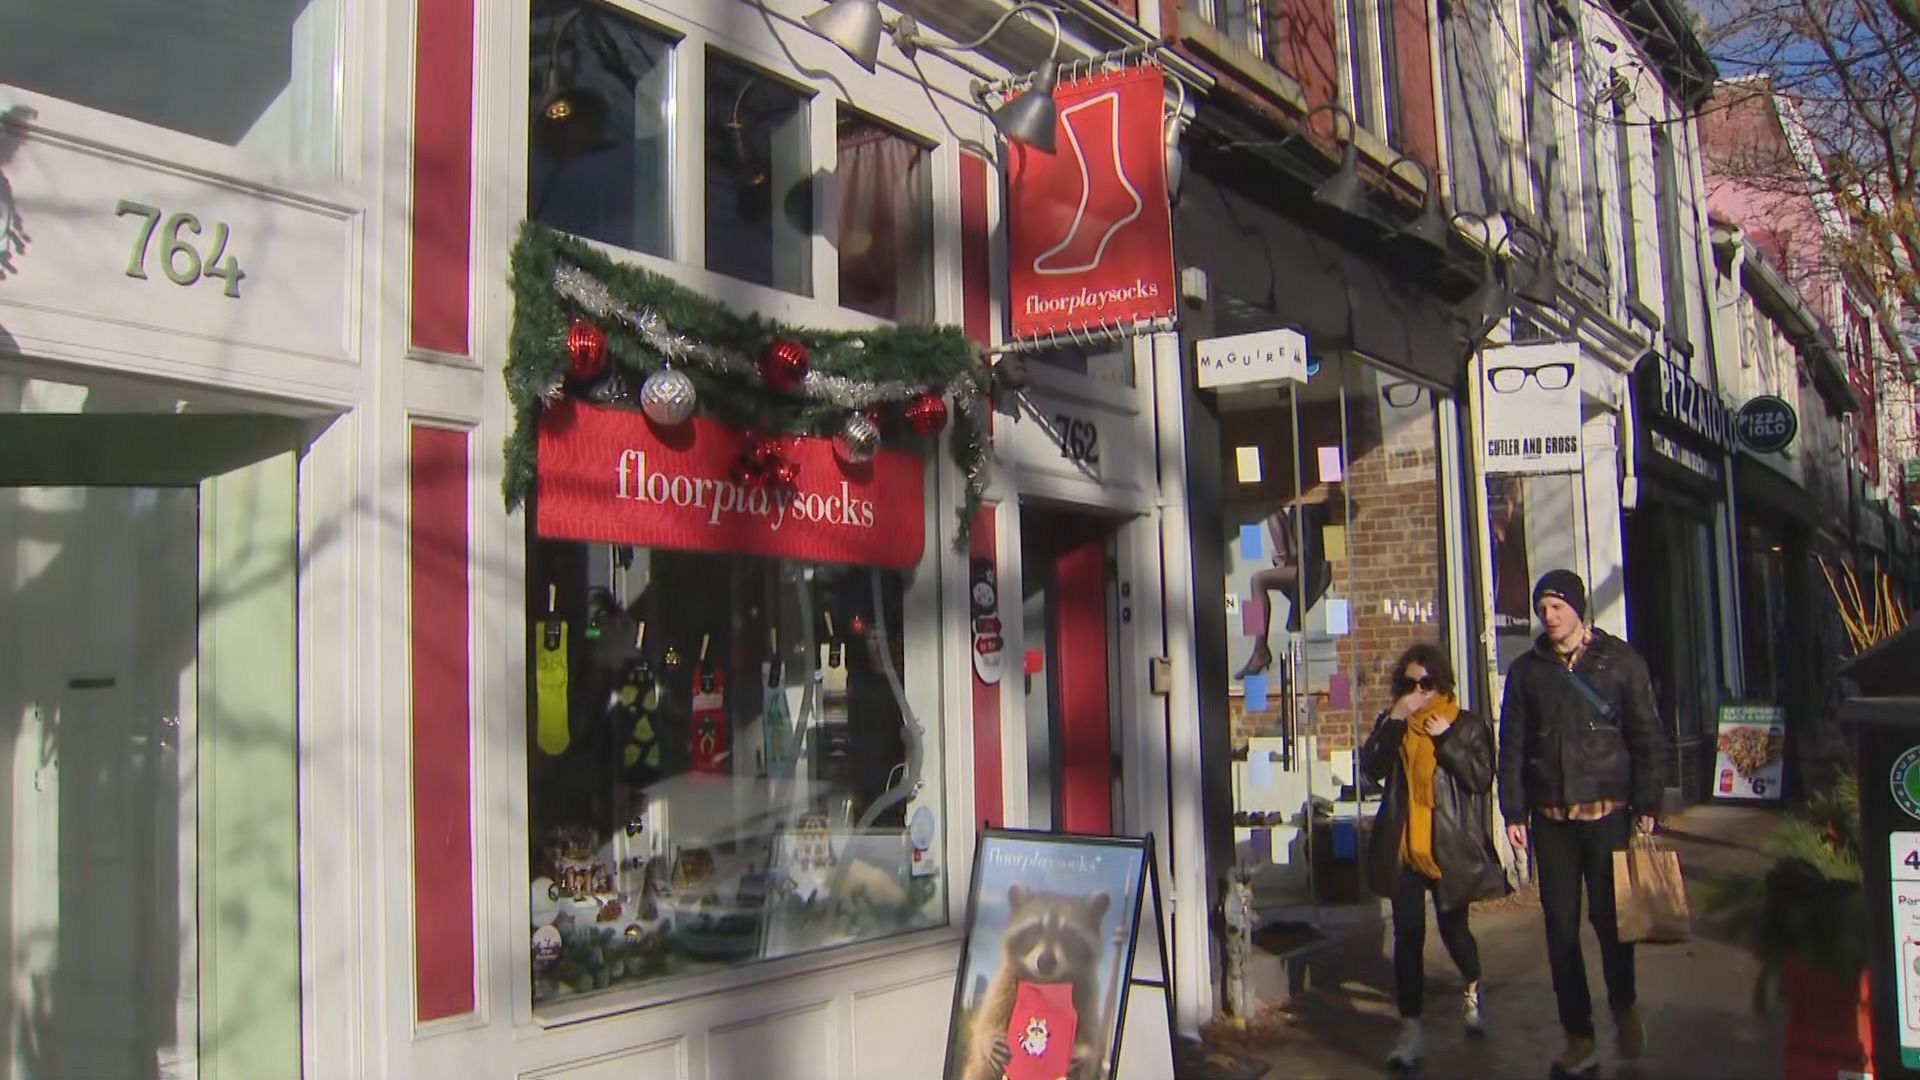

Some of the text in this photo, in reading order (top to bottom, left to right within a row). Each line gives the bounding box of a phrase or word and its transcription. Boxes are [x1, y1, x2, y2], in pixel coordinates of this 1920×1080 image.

[115, 199, 246, 299] 764
[1025, 279, 1159, 315] floorplaysocks
[1200, 346, 1286, 370] MAGUIRE
[1738, 411, 1786, 426] PIZZA
[1749, 422, 1786, 437] IOLO
[1056, 415, 1099, 464] 762
[1488, 436, 1577, 456] CUTLER AND GROSS
[616, 449, 874, 530] floorplaysocks
